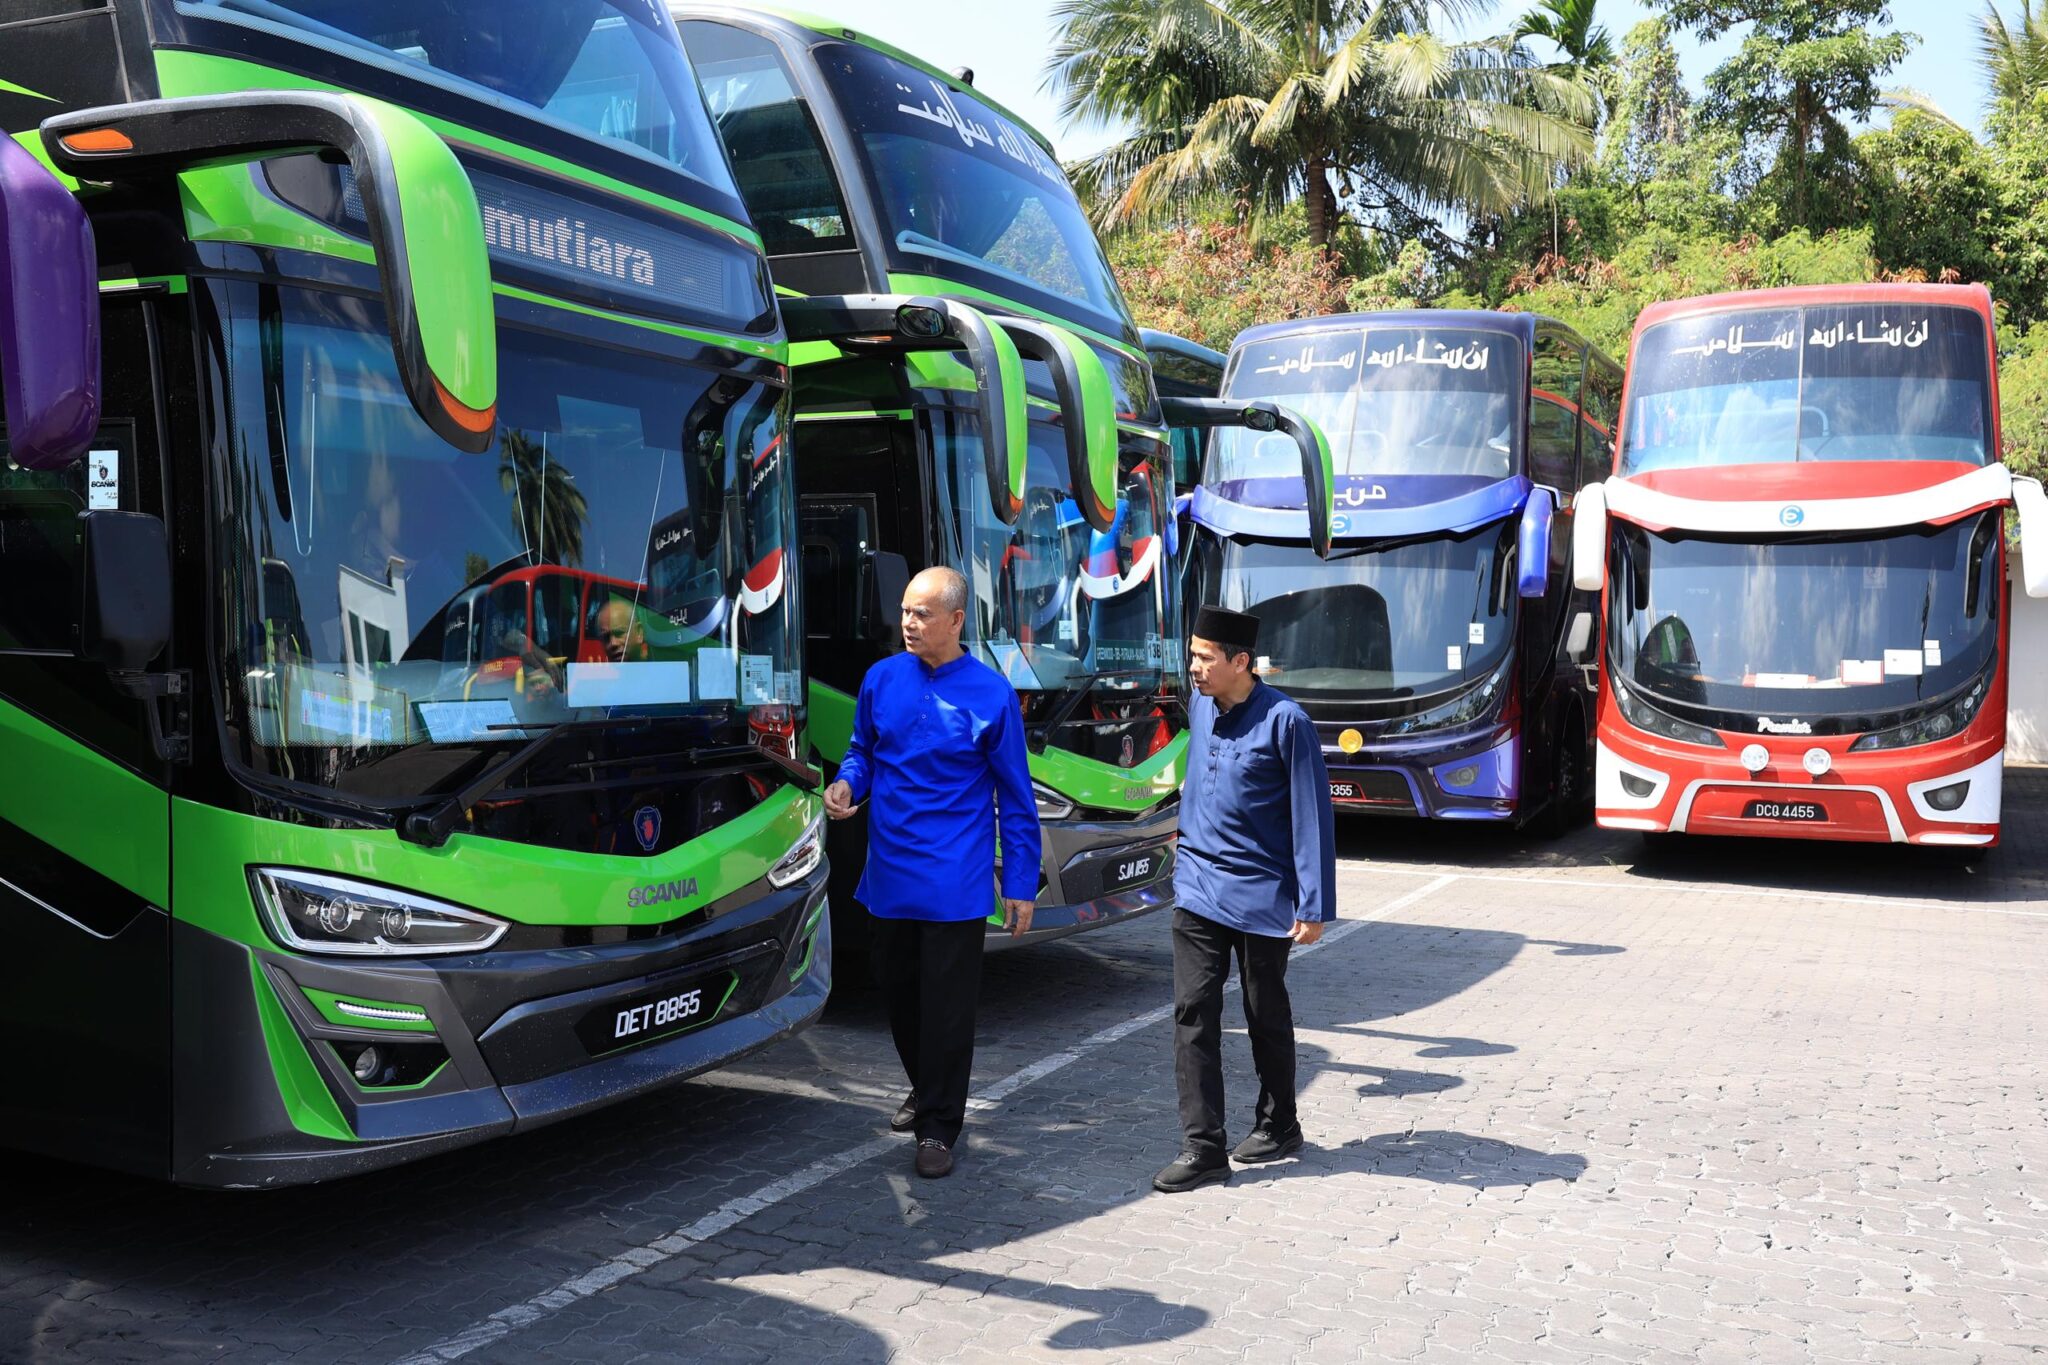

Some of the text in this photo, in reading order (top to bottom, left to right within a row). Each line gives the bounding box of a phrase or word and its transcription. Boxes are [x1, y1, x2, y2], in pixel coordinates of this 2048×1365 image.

[484, 205, 655, 286] mutiara
[1756, 803, 1815, 819] DCQ 4455
[628, 877, 699, 908] SCANIA
[614, 989, 702, 1039] DET 8855
